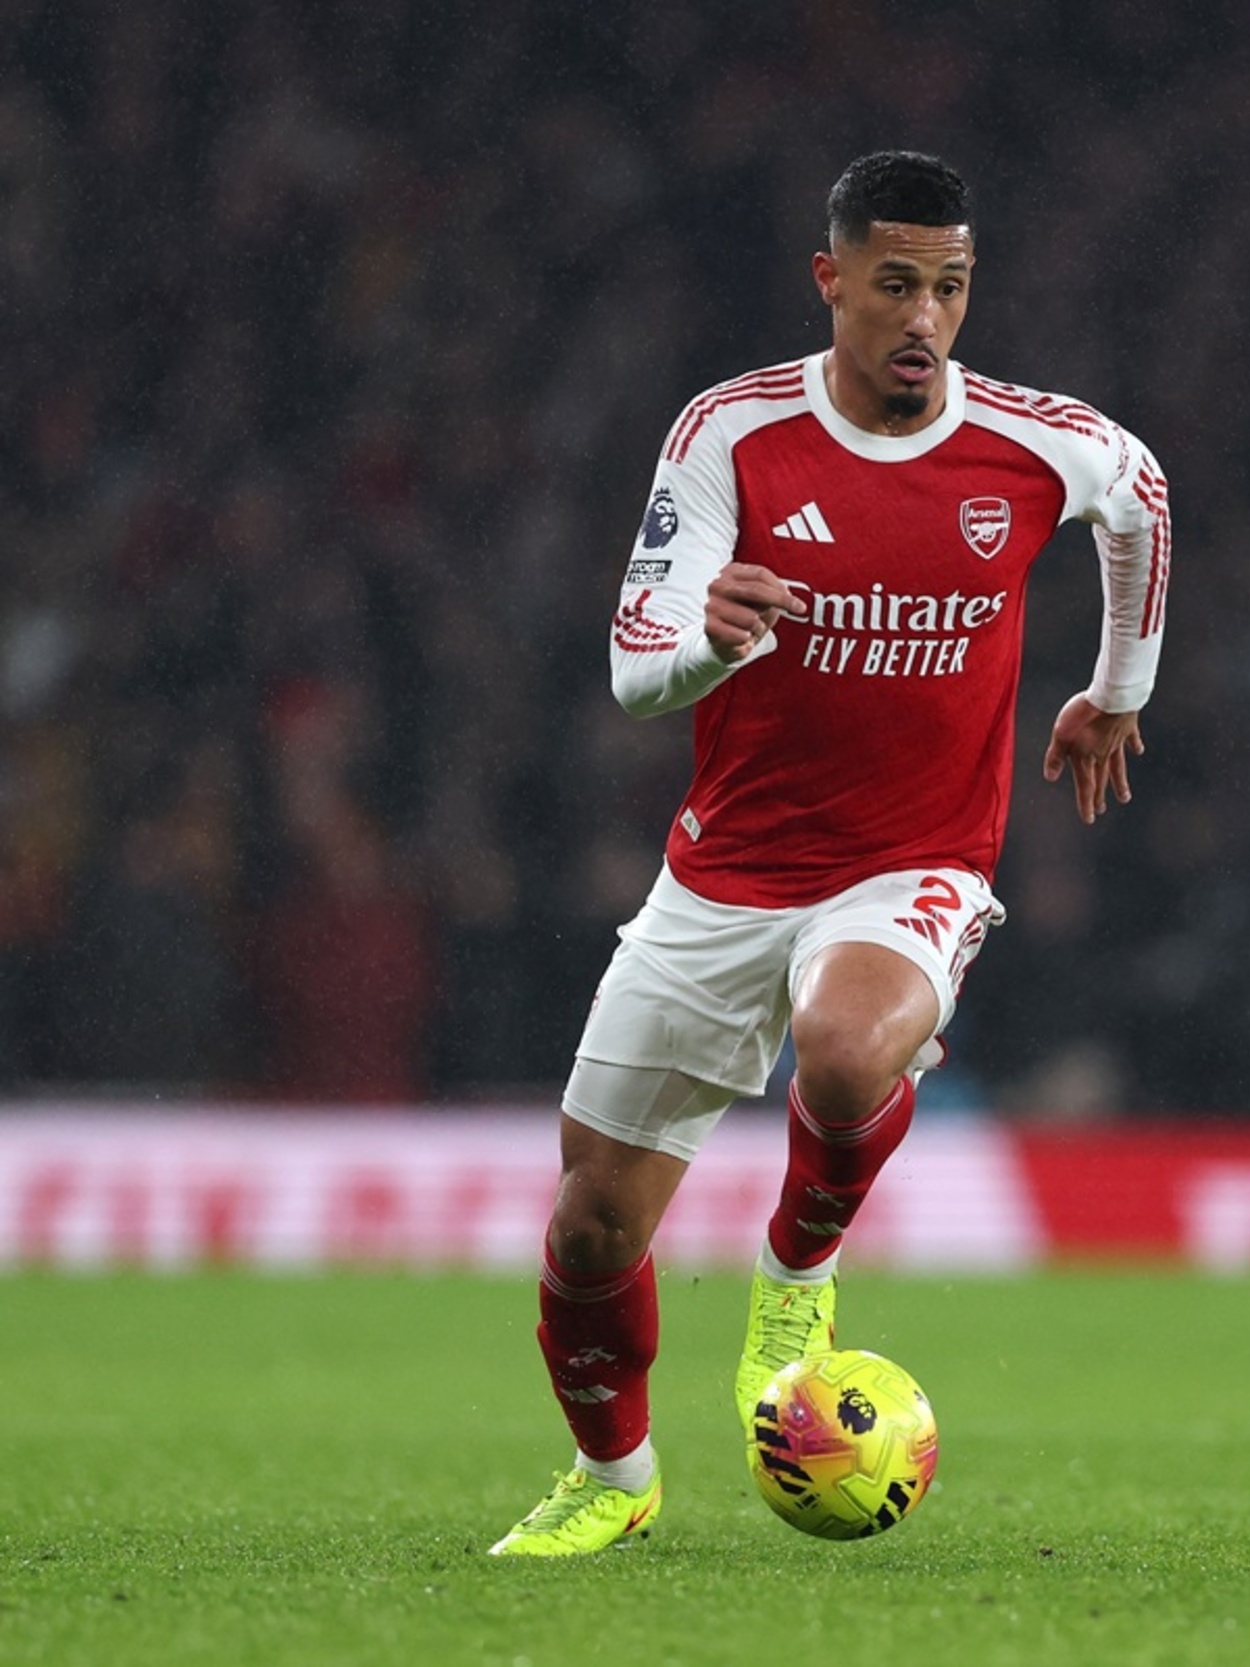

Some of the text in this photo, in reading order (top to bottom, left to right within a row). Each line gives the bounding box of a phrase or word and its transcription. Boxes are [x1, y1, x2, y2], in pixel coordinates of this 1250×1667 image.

[803, 634, 970, 677] FLY BETTER
[912, 875, 962, 934] 2
